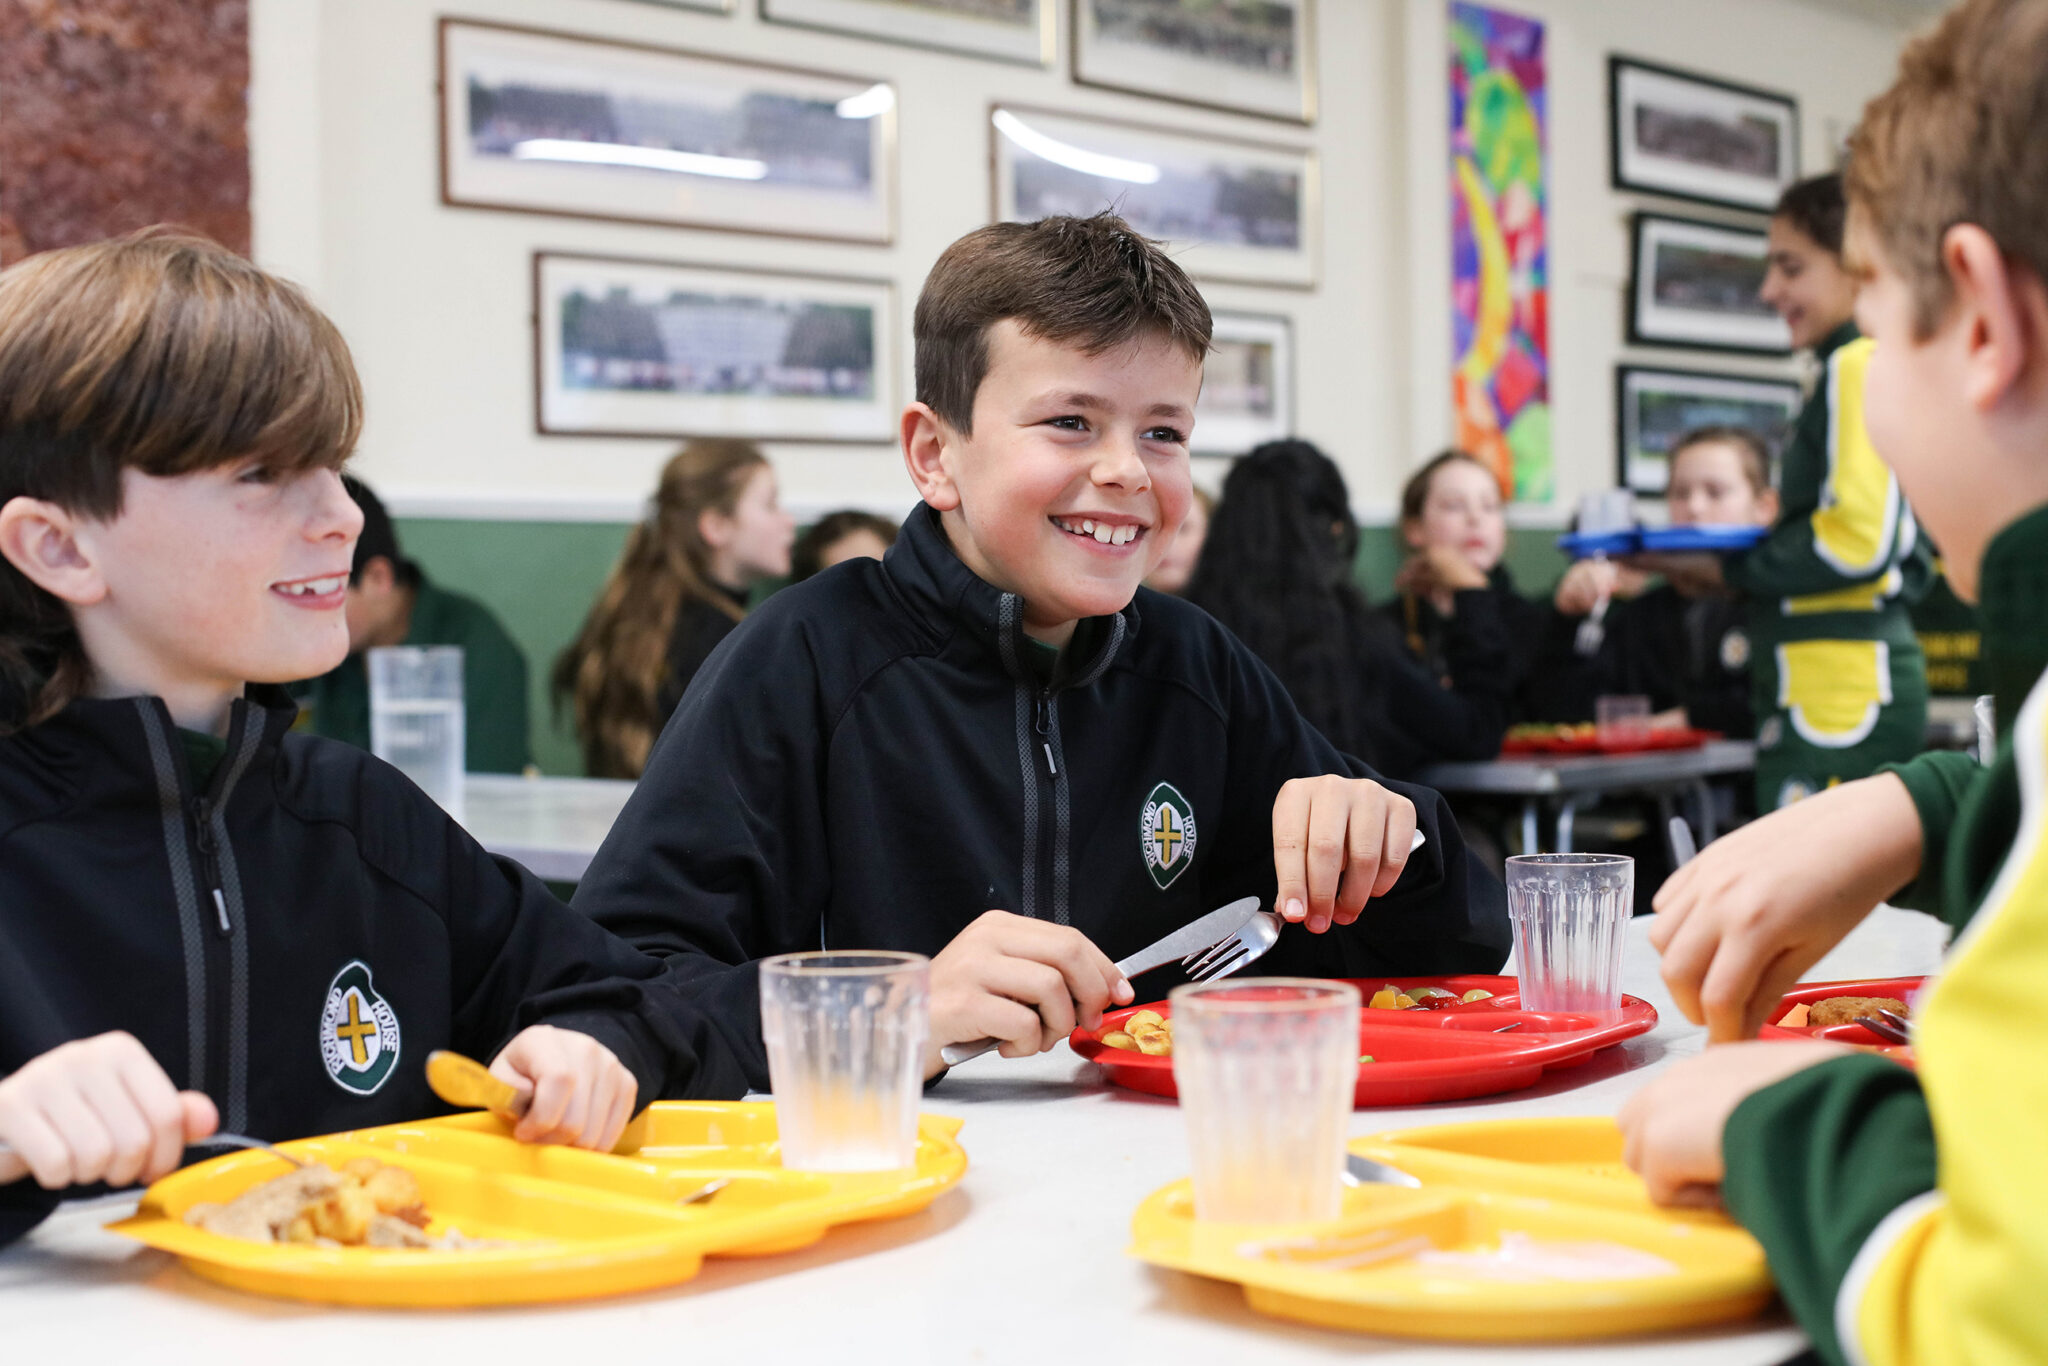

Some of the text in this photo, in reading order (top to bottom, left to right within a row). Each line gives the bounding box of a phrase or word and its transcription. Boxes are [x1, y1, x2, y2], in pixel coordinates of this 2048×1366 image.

[1142, 801, 1196, 869] RICHMOND HOUSE
[321, 987, 397, 1076] RICHMOND HOUSE
